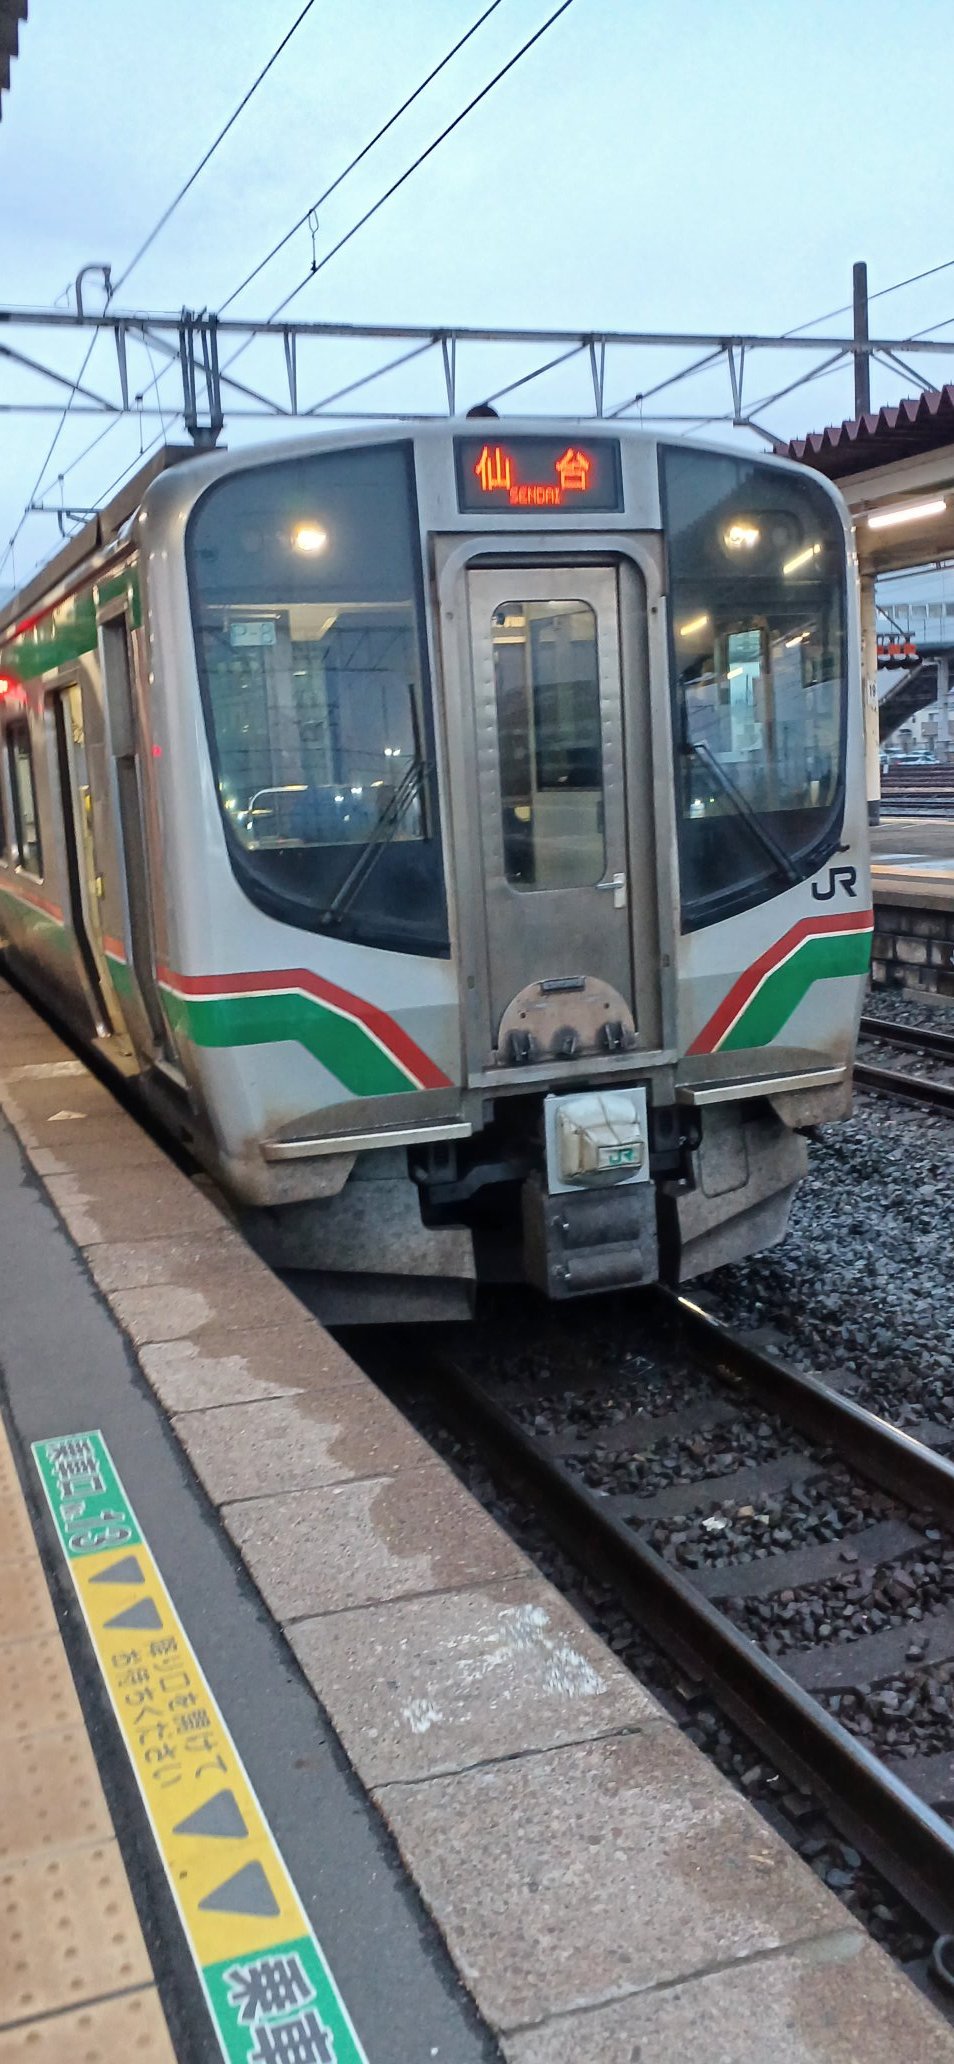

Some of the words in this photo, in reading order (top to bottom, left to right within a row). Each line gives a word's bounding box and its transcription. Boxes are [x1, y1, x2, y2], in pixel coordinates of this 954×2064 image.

[509, 486, 561, 504] SENDAI
[812, 866, 857, 900] JR
[609, 1148, 635, 1165] JR
